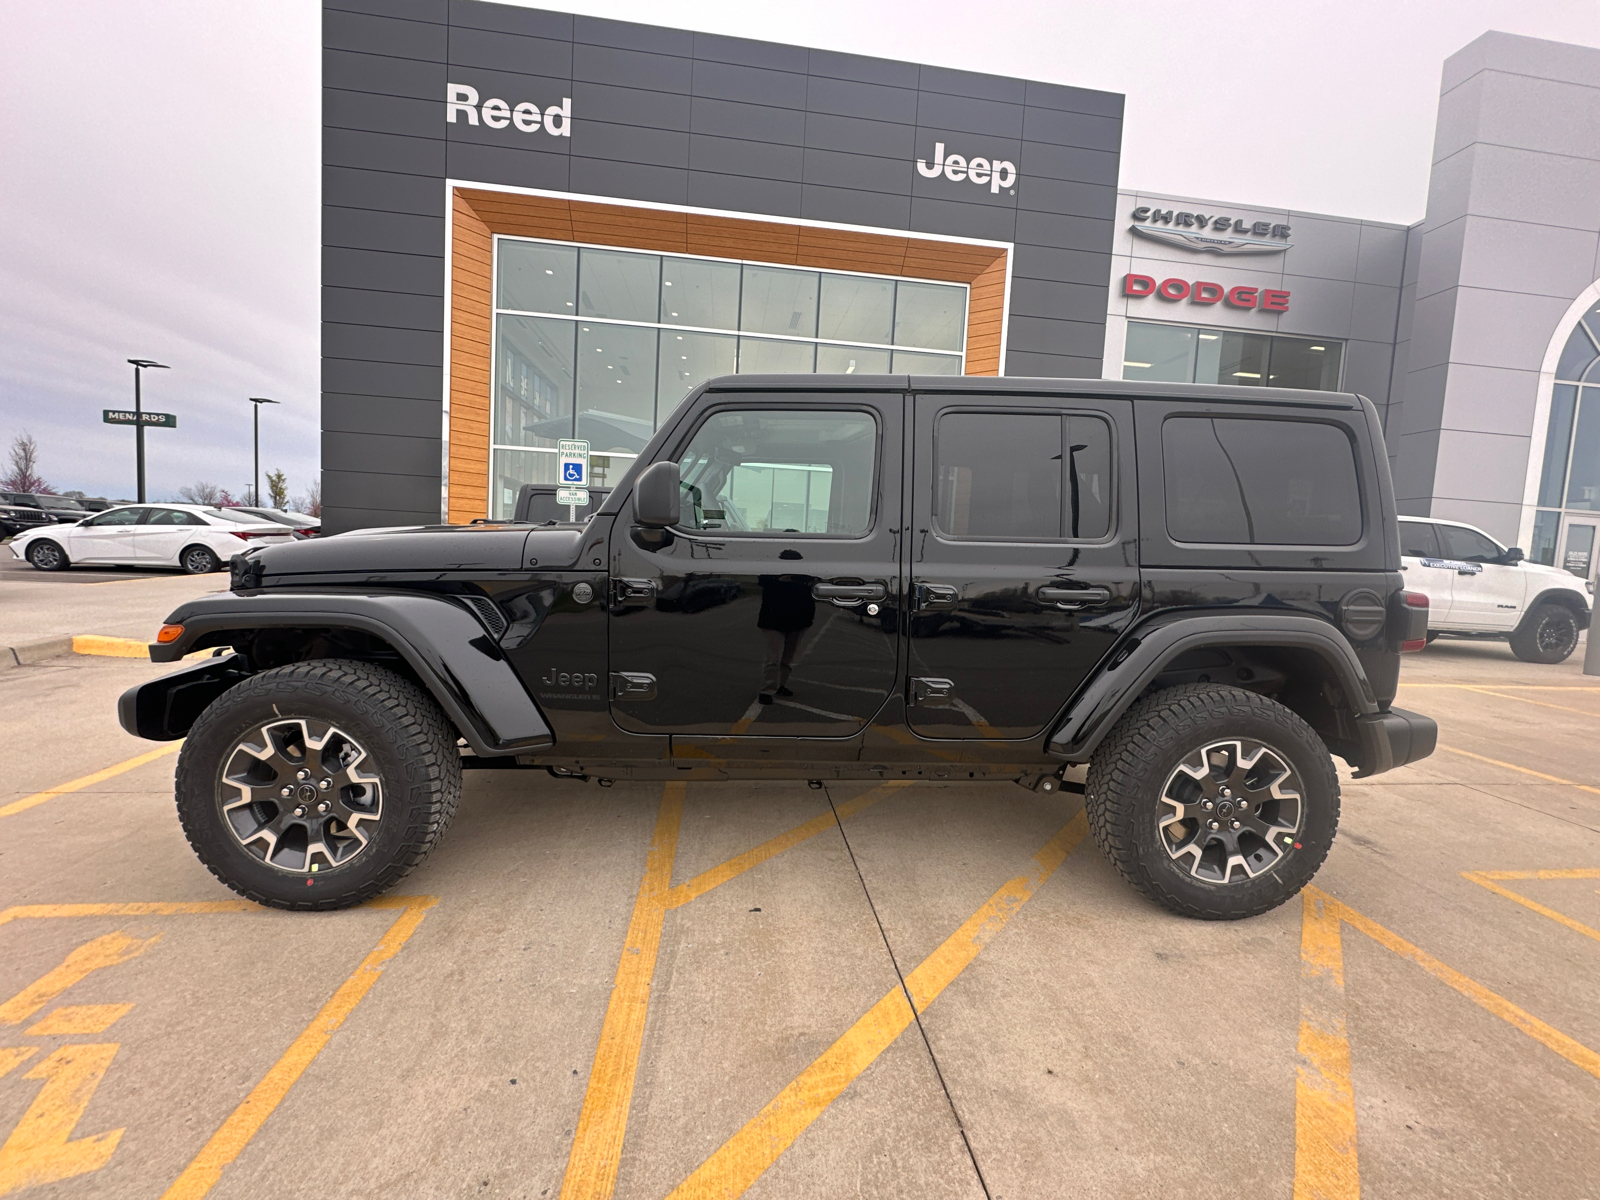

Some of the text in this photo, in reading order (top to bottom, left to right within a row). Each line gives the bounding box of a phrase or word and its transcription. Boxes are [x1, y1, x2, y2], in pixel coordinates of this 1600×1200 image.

[446, 82, 572, 137] Reed
[1132, 206, 1292, 238] CHRYSLER
[1122, 273, 1291, 313] DODGE
[108, 412, 166, 421] MENRDS
[561, 444, 587, 452] RESERVED
[542, 668, 599, 691] Jeep
